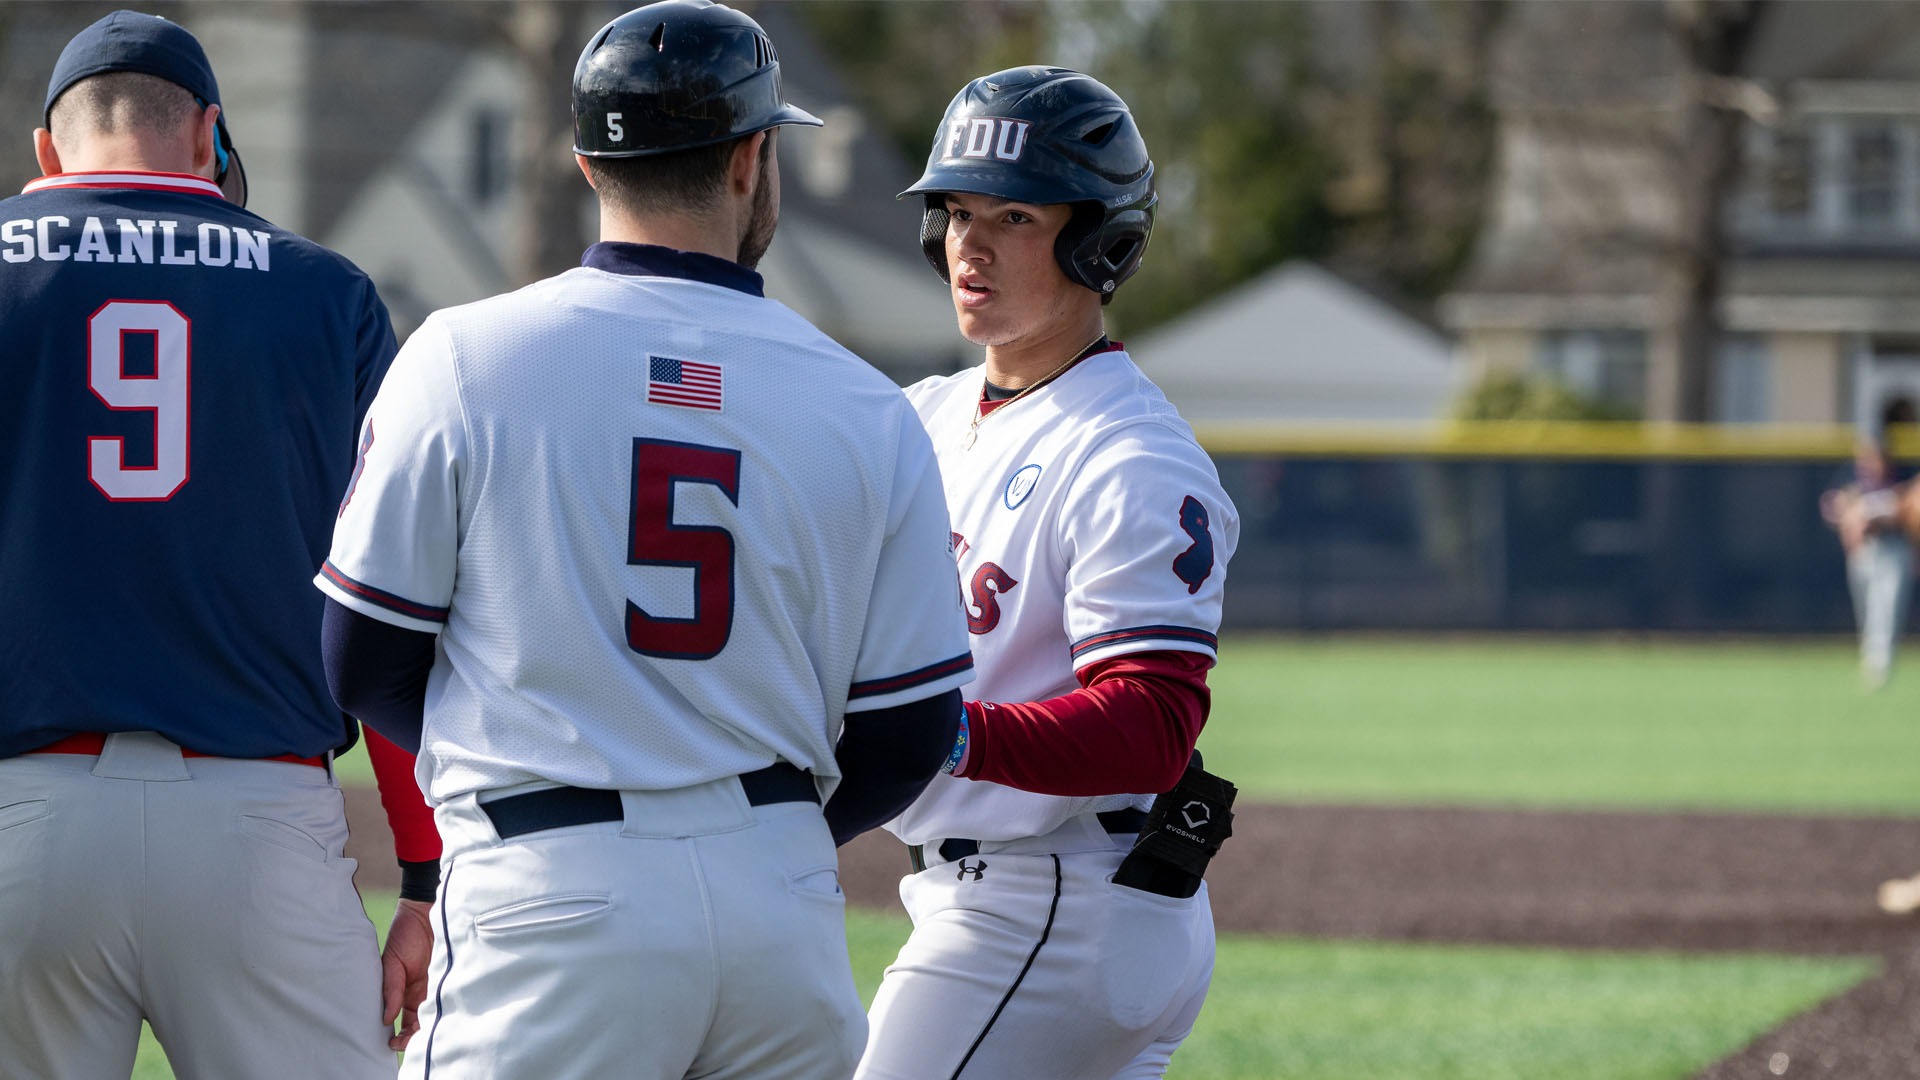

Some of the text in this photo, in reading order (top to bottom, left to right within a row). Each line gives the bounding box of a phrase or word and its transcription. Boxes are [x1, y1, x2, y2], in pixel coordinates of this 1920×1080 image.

[607, 112, 623, 142] 5
[942, 118, 1031, 161] FDU
[1, 215, 271, 272] SCANLON
[87, 298, 191, 502] 9
[624, 437, 741, 661] 5
